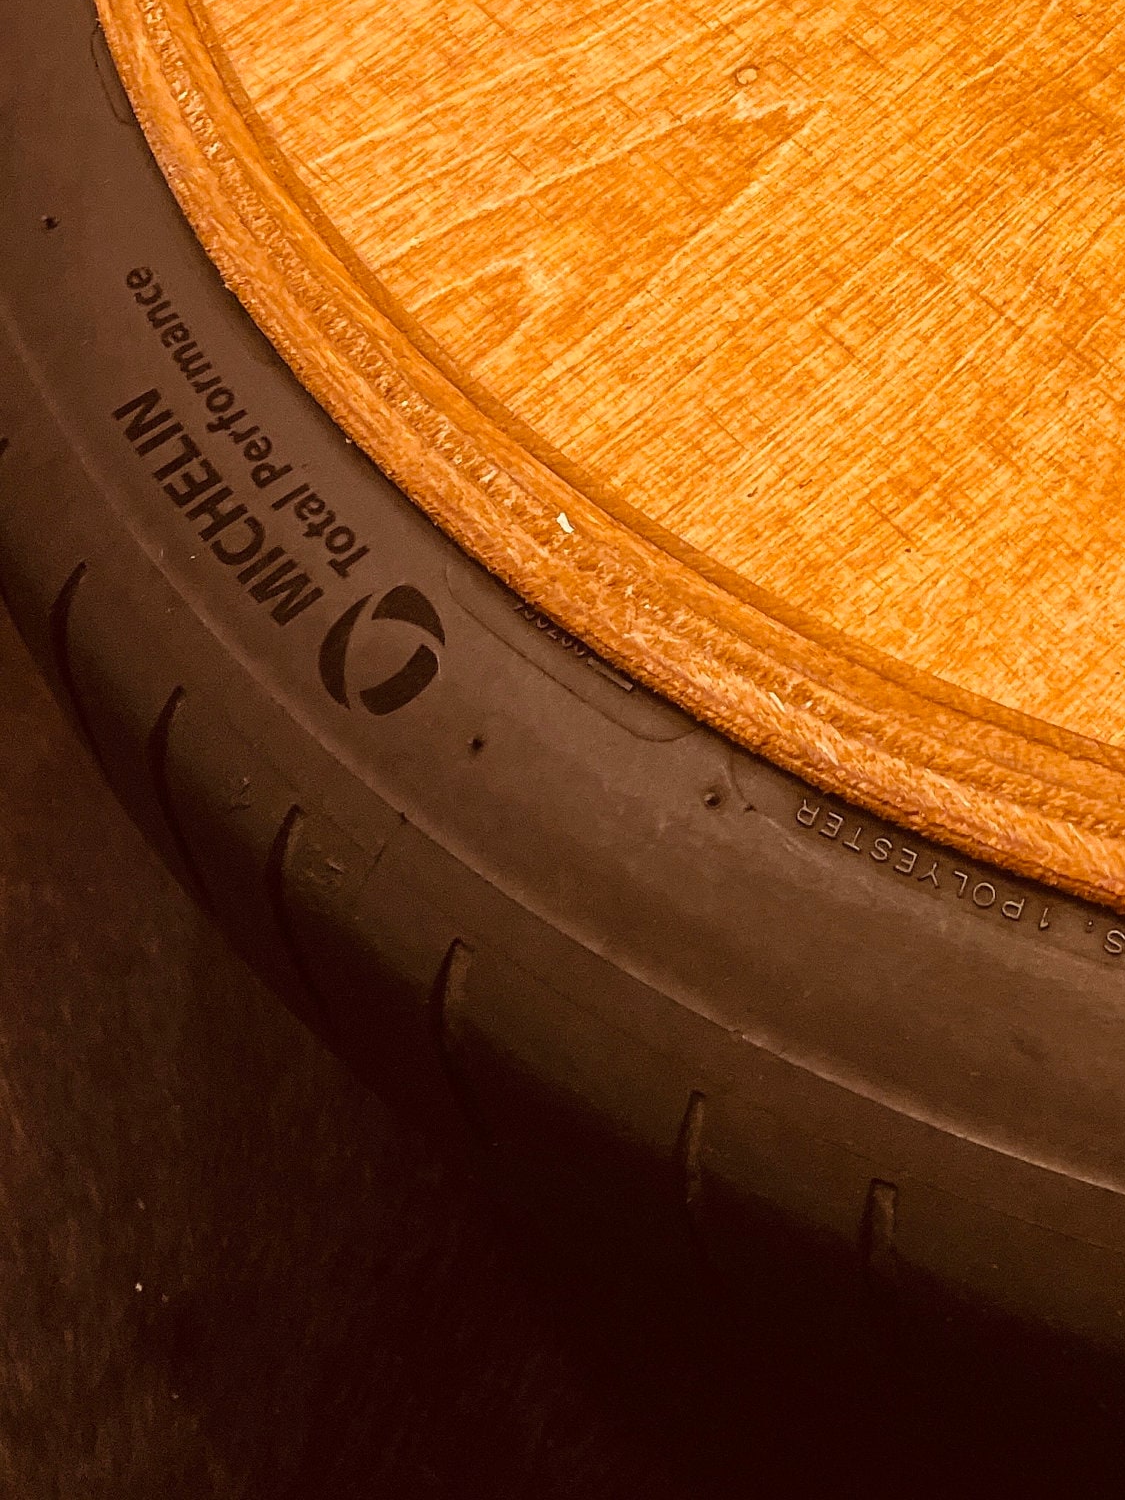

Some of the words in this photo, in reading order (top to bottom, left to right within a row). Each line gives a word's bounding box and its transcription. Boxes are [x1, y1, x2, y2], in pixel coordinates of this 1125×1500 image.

[126, 266, 293, 488] Performance
[111, 388, 325, 627] MICHELIN
[271, 483, 371, 578] Total
